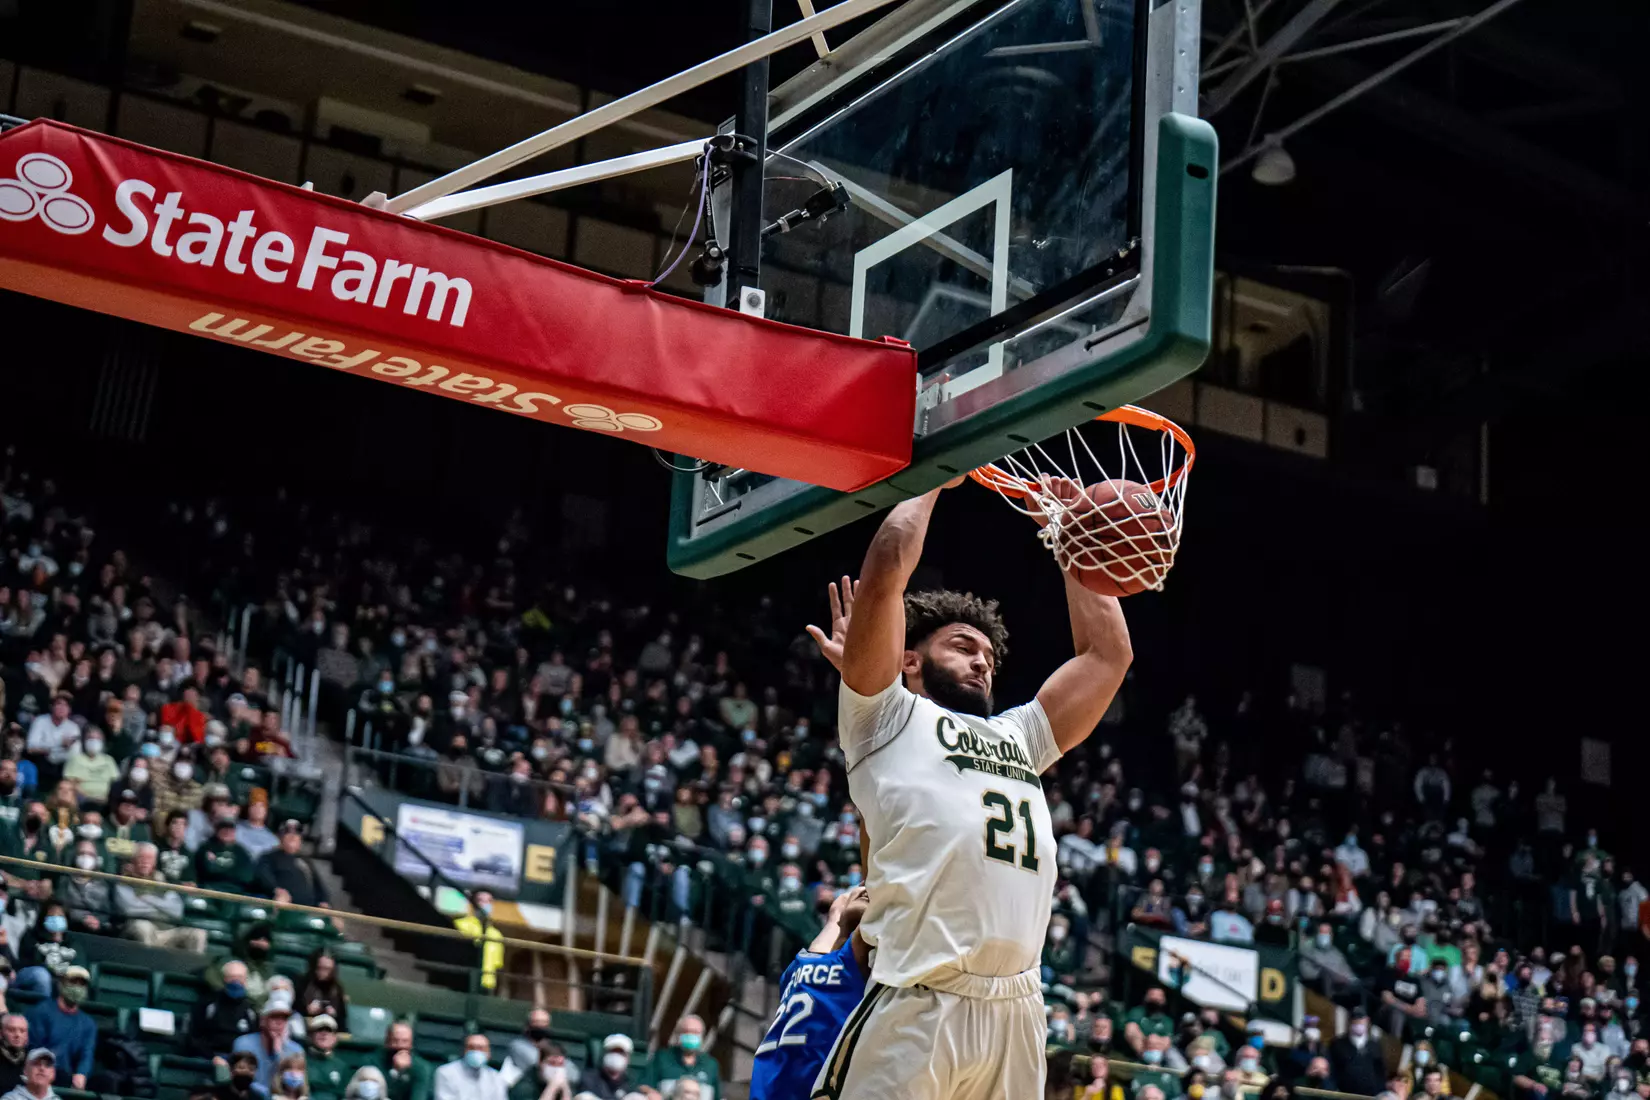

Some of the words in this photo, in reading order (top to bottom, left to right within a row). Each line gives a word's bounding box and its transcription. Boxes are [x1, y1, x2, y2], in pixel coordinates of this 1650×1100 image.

[973, 758, 1002, 776] STATE
[1005, 765, 1027, 781] UNIV
[980, 788, 1041, 876] 21
[525, 843, 556, 884] E
[1260, 967, 1286, 1002] D
[754, 992, 814, 1056] 22
